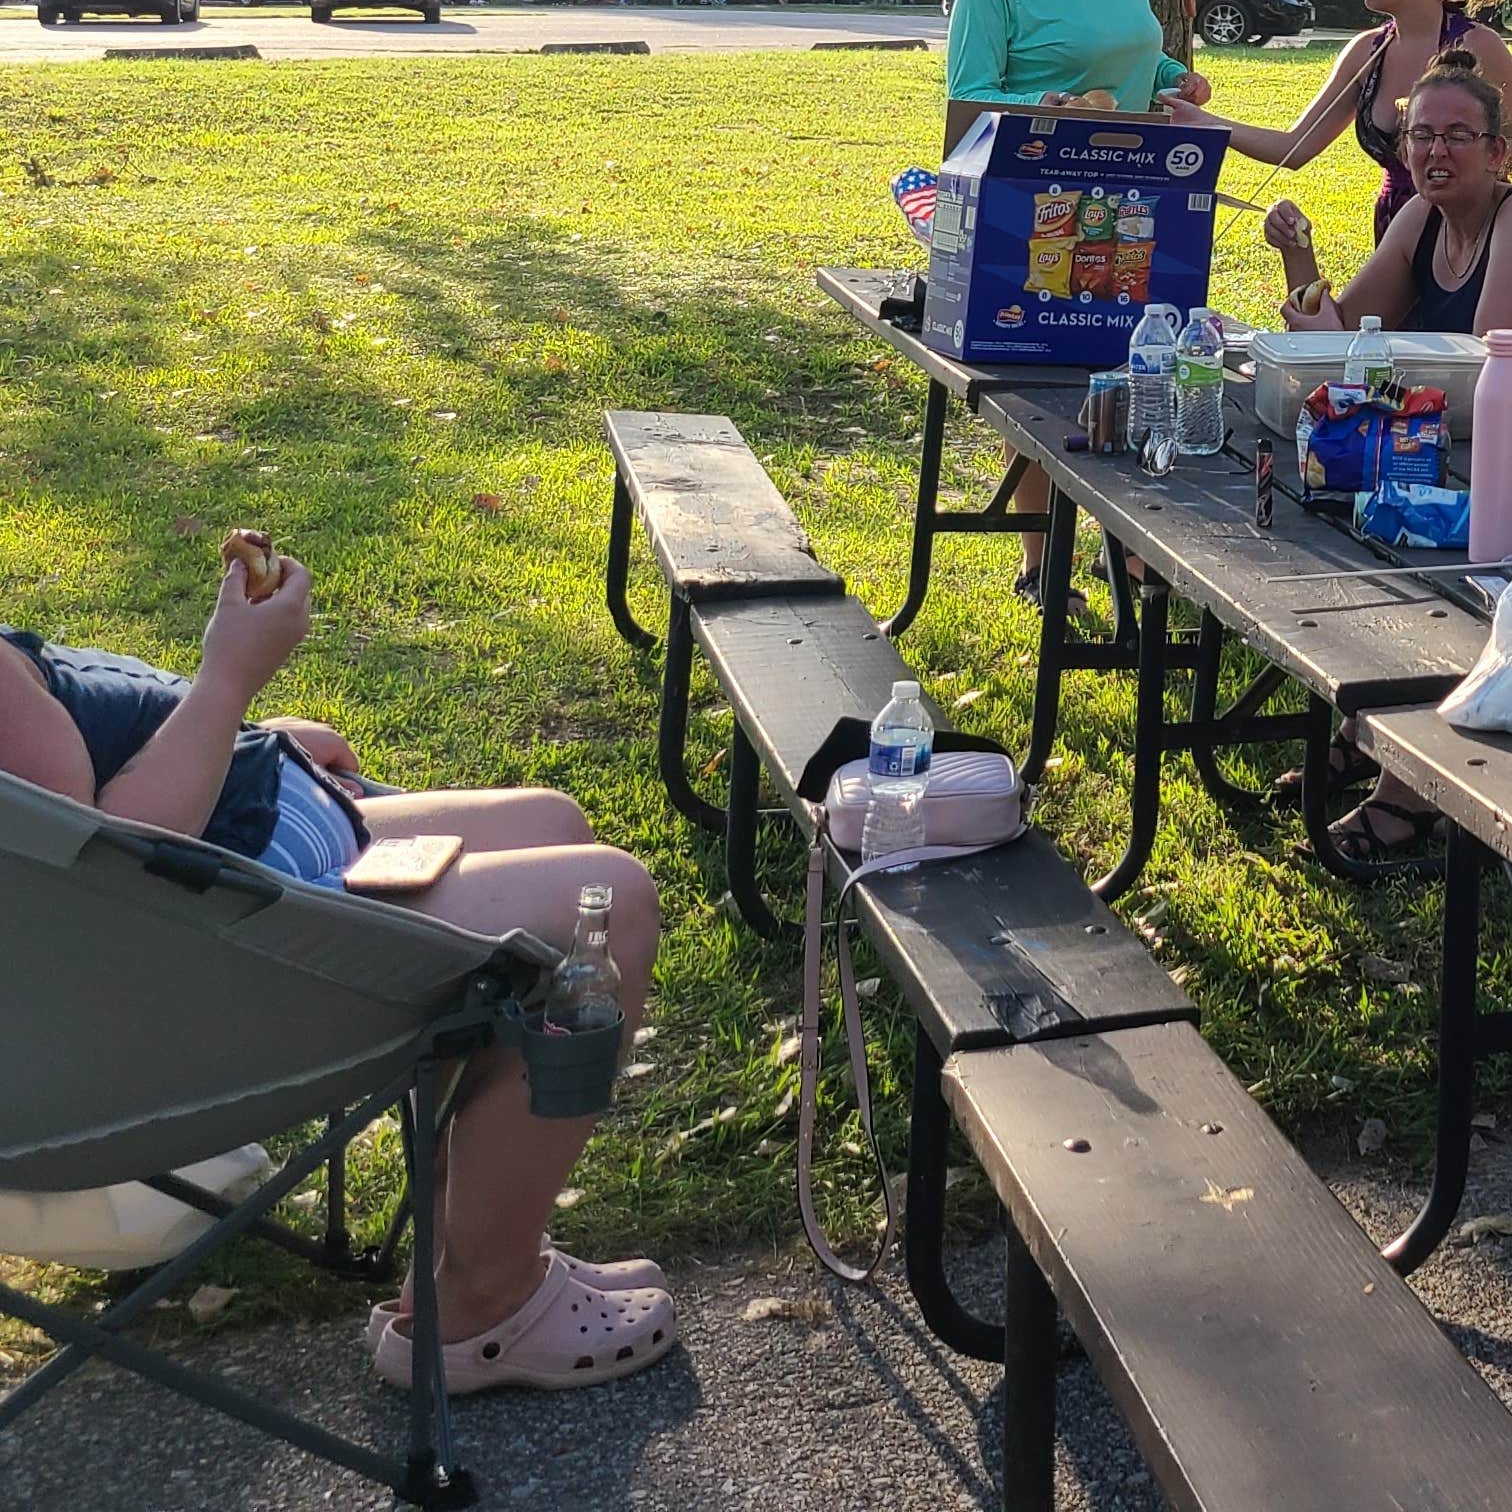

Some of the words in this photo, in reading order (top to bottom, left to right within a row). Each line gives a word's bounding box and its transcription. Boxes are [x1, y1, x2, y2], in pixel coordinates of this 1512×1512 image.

[1059, 147, 1123, 162] CLASSIC
[1127, 151, 1156, 164] MIX
[1170, 150, 1199, 166] 50
[1094, 188, 1101, 197] 4
[1130, 190, 1137, 199] 4
[1037, 201, 1071, 223] Fritos
[1074, 254, 1106, 264] Doritos
[1081, 292, 1091, 302] 10
[1119, 294, 1130, 303] 16
[1038, 312, 1102, 326] CLASSIC
[1106, 314, 1134, 328] MIX
